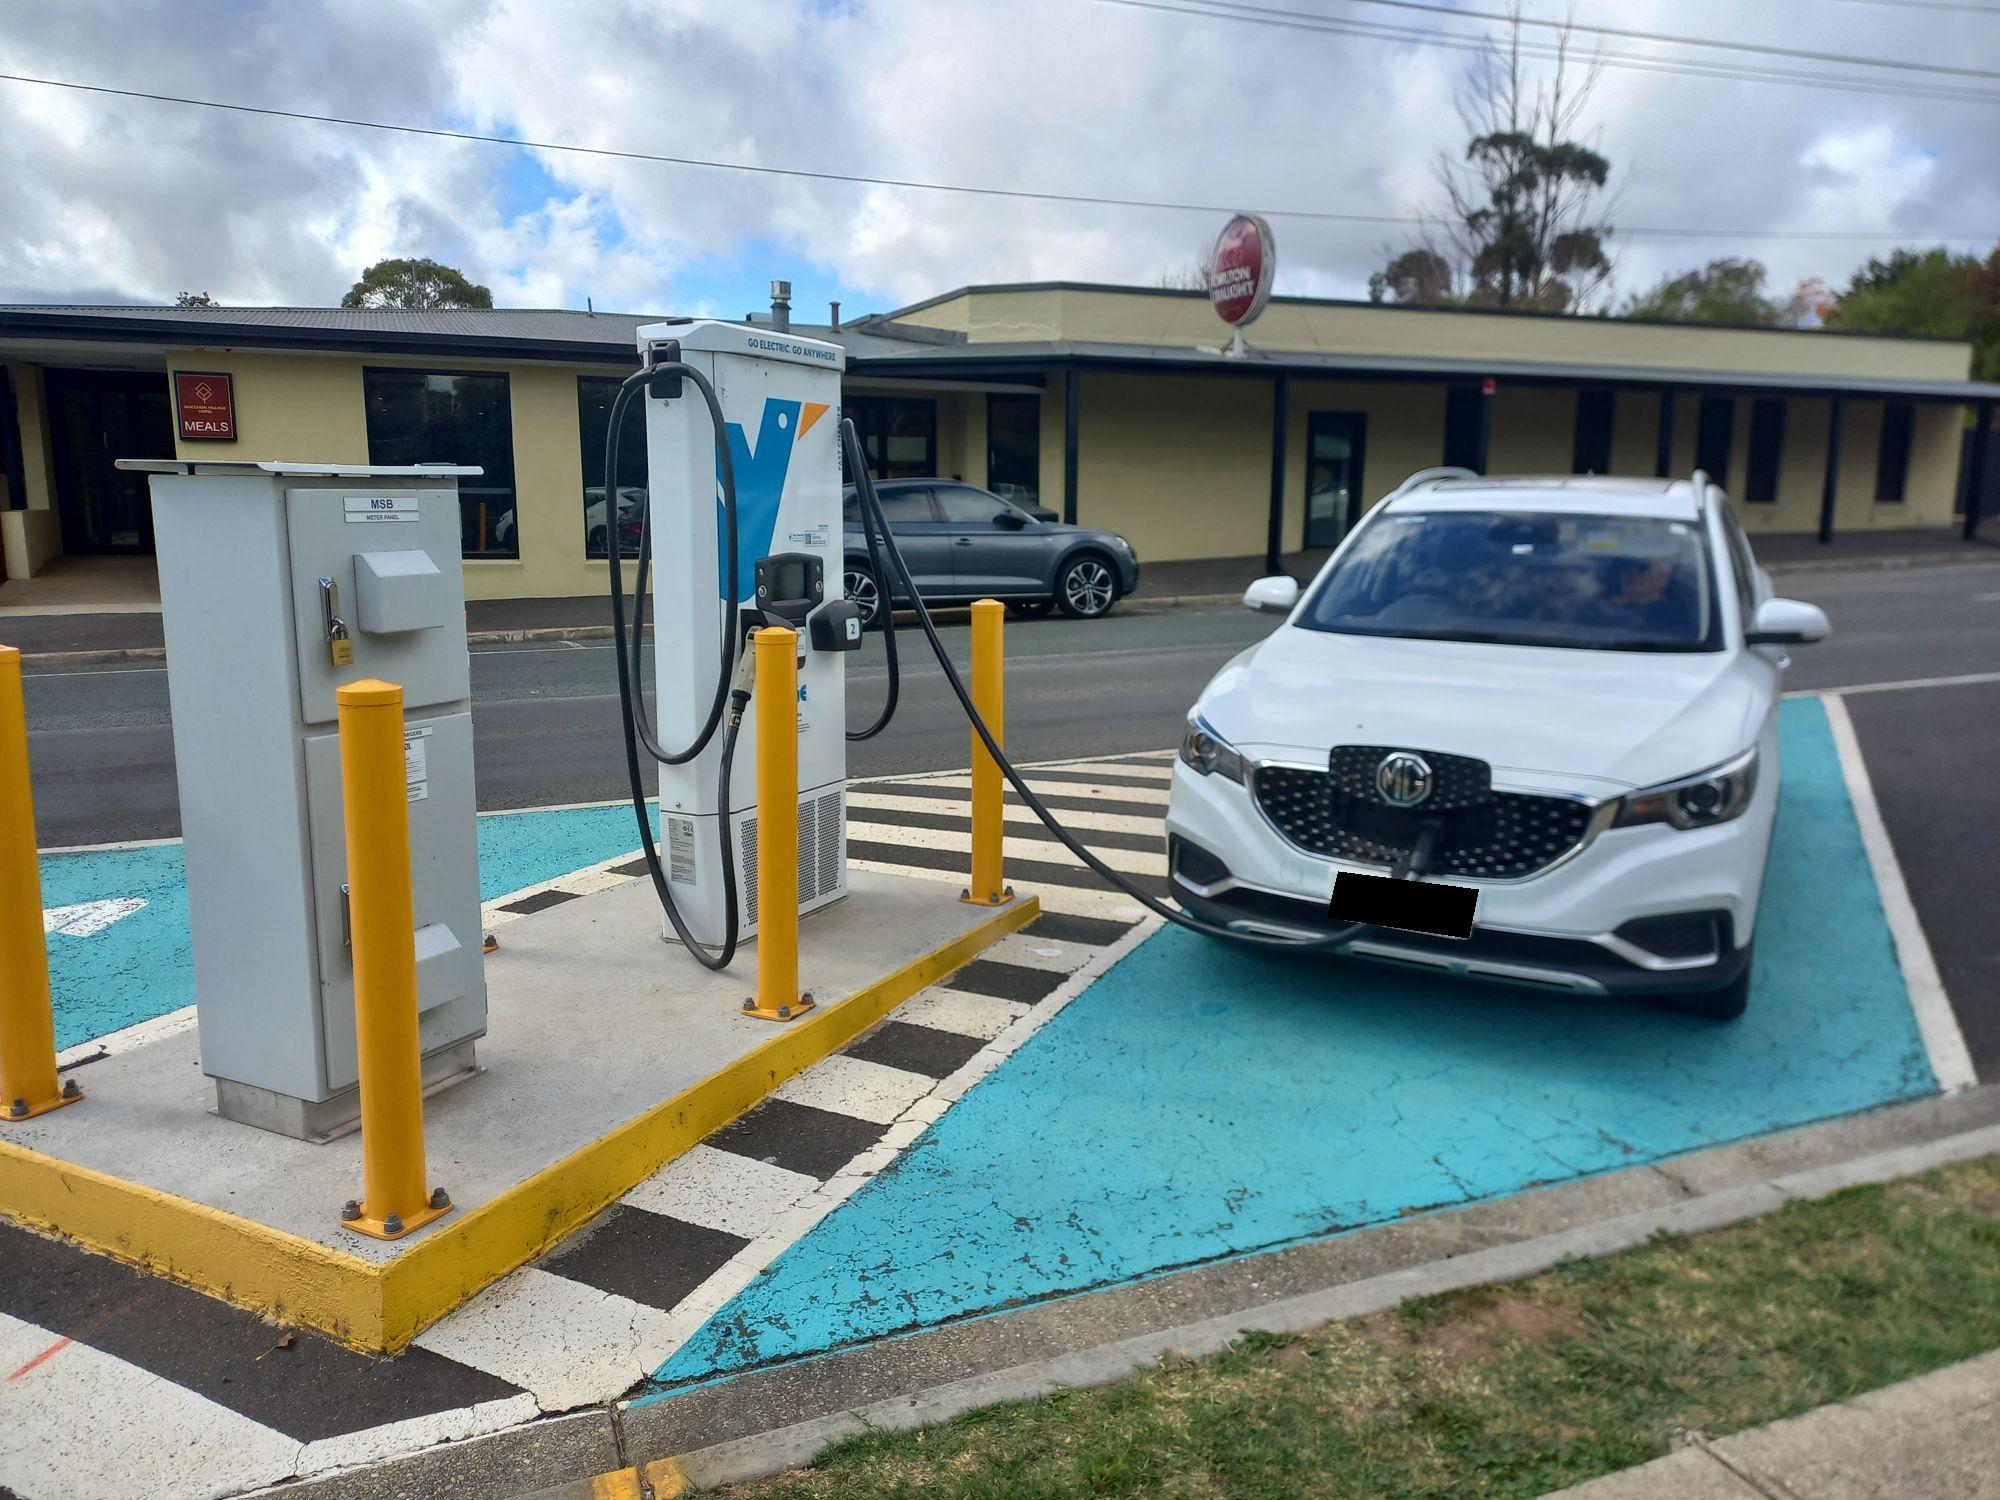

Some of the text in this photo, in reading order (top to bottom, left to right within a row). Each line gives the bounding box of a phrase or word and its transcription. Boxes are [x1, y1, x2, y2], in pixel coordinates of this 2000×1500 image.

[748, 338, 836, 361] GO ELECTRIC. GO ANYWHERE
[185, 421, 229, 432] MEALS
[371, 499, 394, 509] MSB
[850, 623, 856, 635] 2
[1381, 758, 1425, 801] MG
